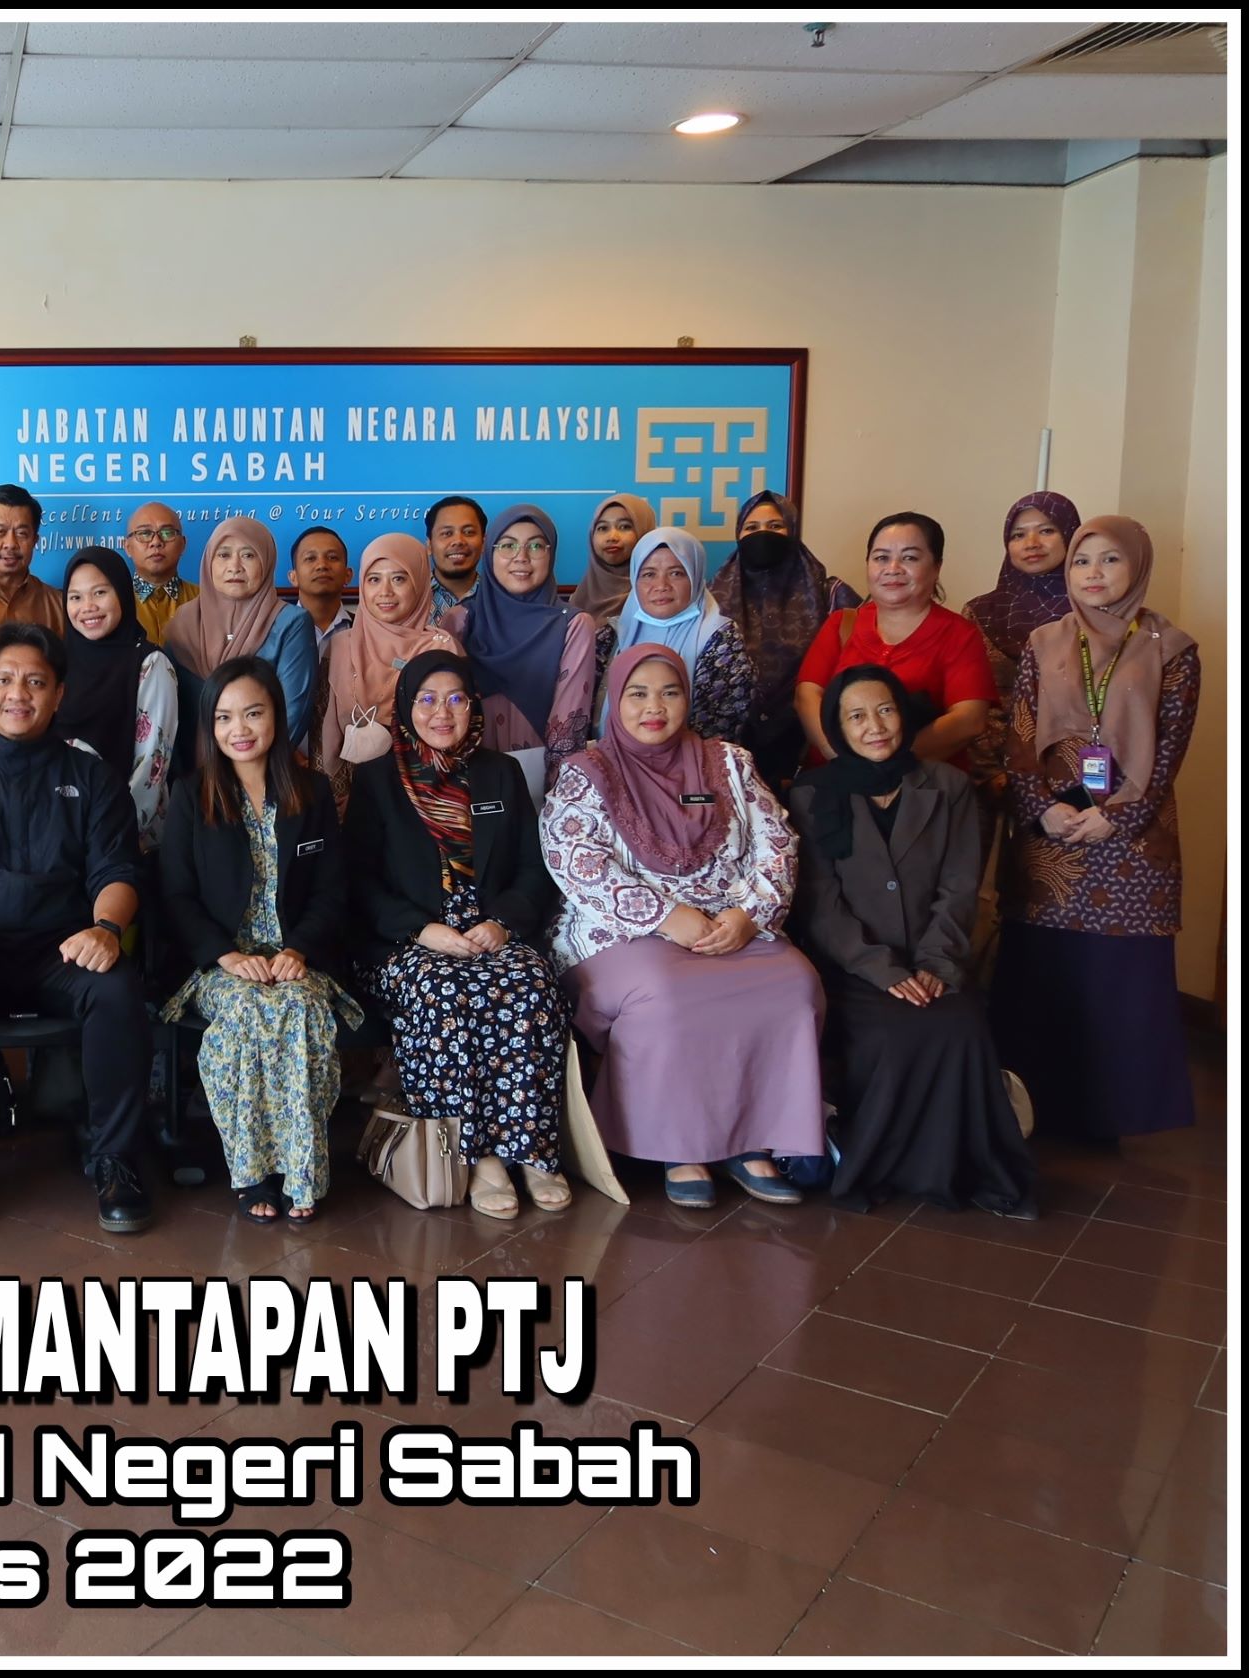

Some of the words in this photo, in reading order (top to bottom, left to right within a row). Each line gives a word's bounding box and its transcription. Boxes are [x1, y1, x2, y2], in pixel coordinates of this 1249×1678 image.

[16, 407, 148, 444] JABATAN
[172, 406, 325, 443] AKAUNTAN
[347, 406, 456, 442] NEGARA
[475, 405, 621, 442] MALAYSIA
[17, 452, 167, 484] NEGERI
[190, 451, 326, 482] SABAH
[268, 504, 284, 521] @
[294, 503, 345, 521] Your
